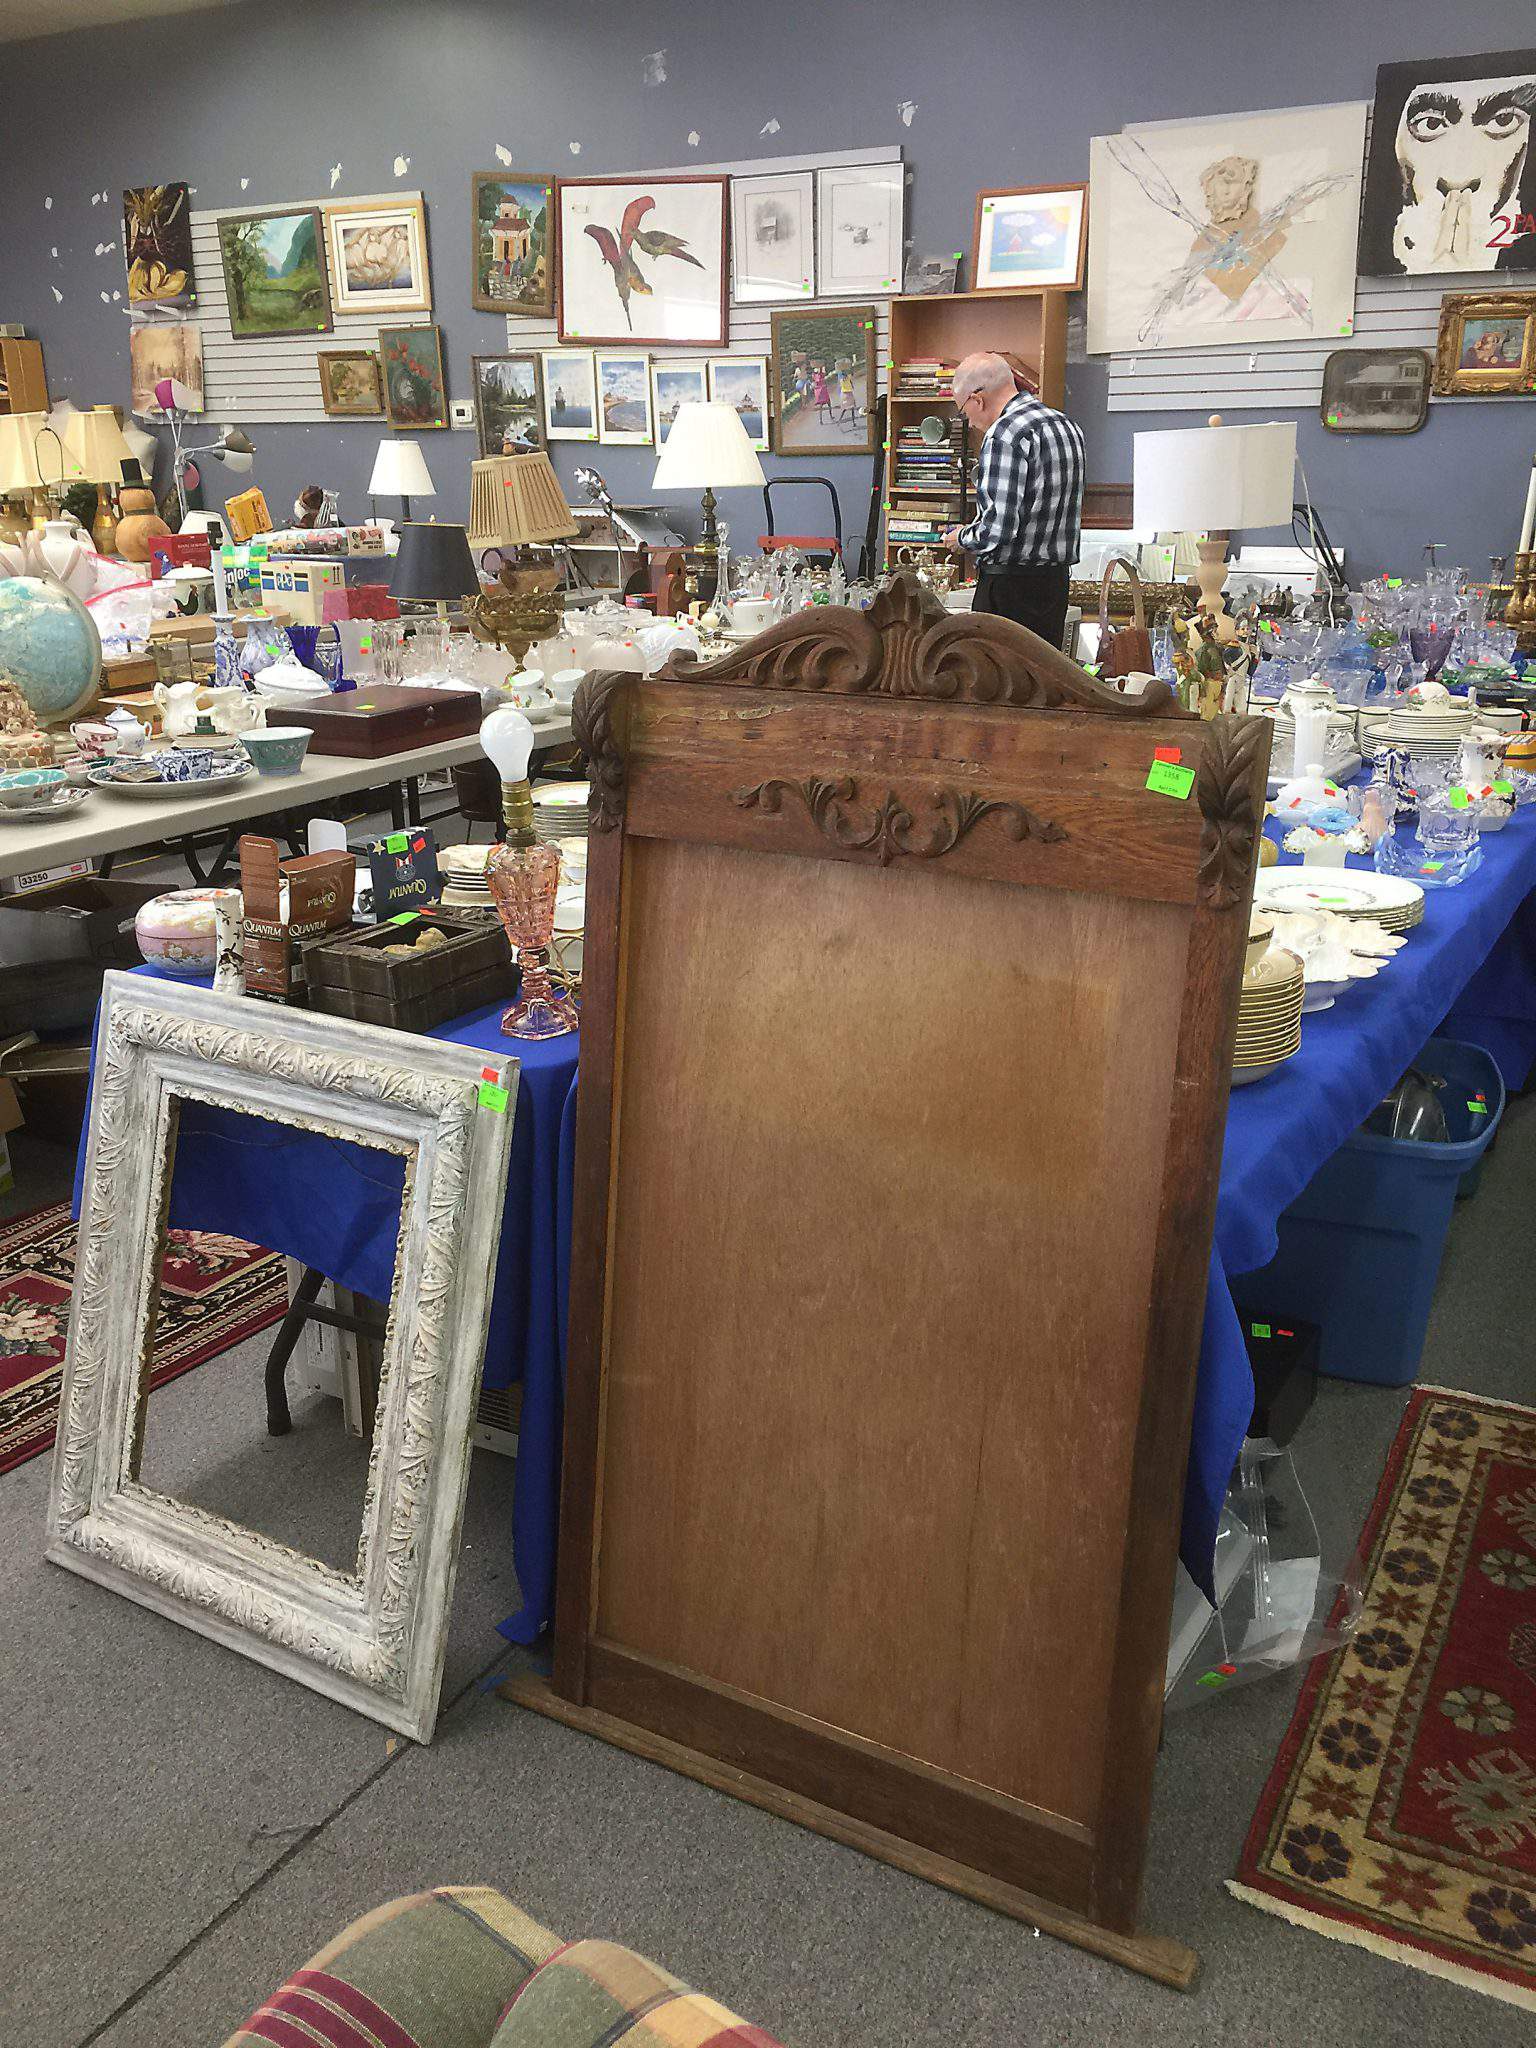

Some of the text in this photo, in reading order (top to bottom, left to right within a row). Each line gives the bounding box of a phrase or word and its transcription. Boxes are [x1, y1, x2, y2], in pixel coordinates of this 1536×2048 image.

[276, 573, 293, 588] PPG
[21, 872, 49, 886] 33250
[388, 879, 427, 900] QUANTUM
[242, 919, 282, 936] QUANTUM
[288, 919, 327, 937] QUANTUM
